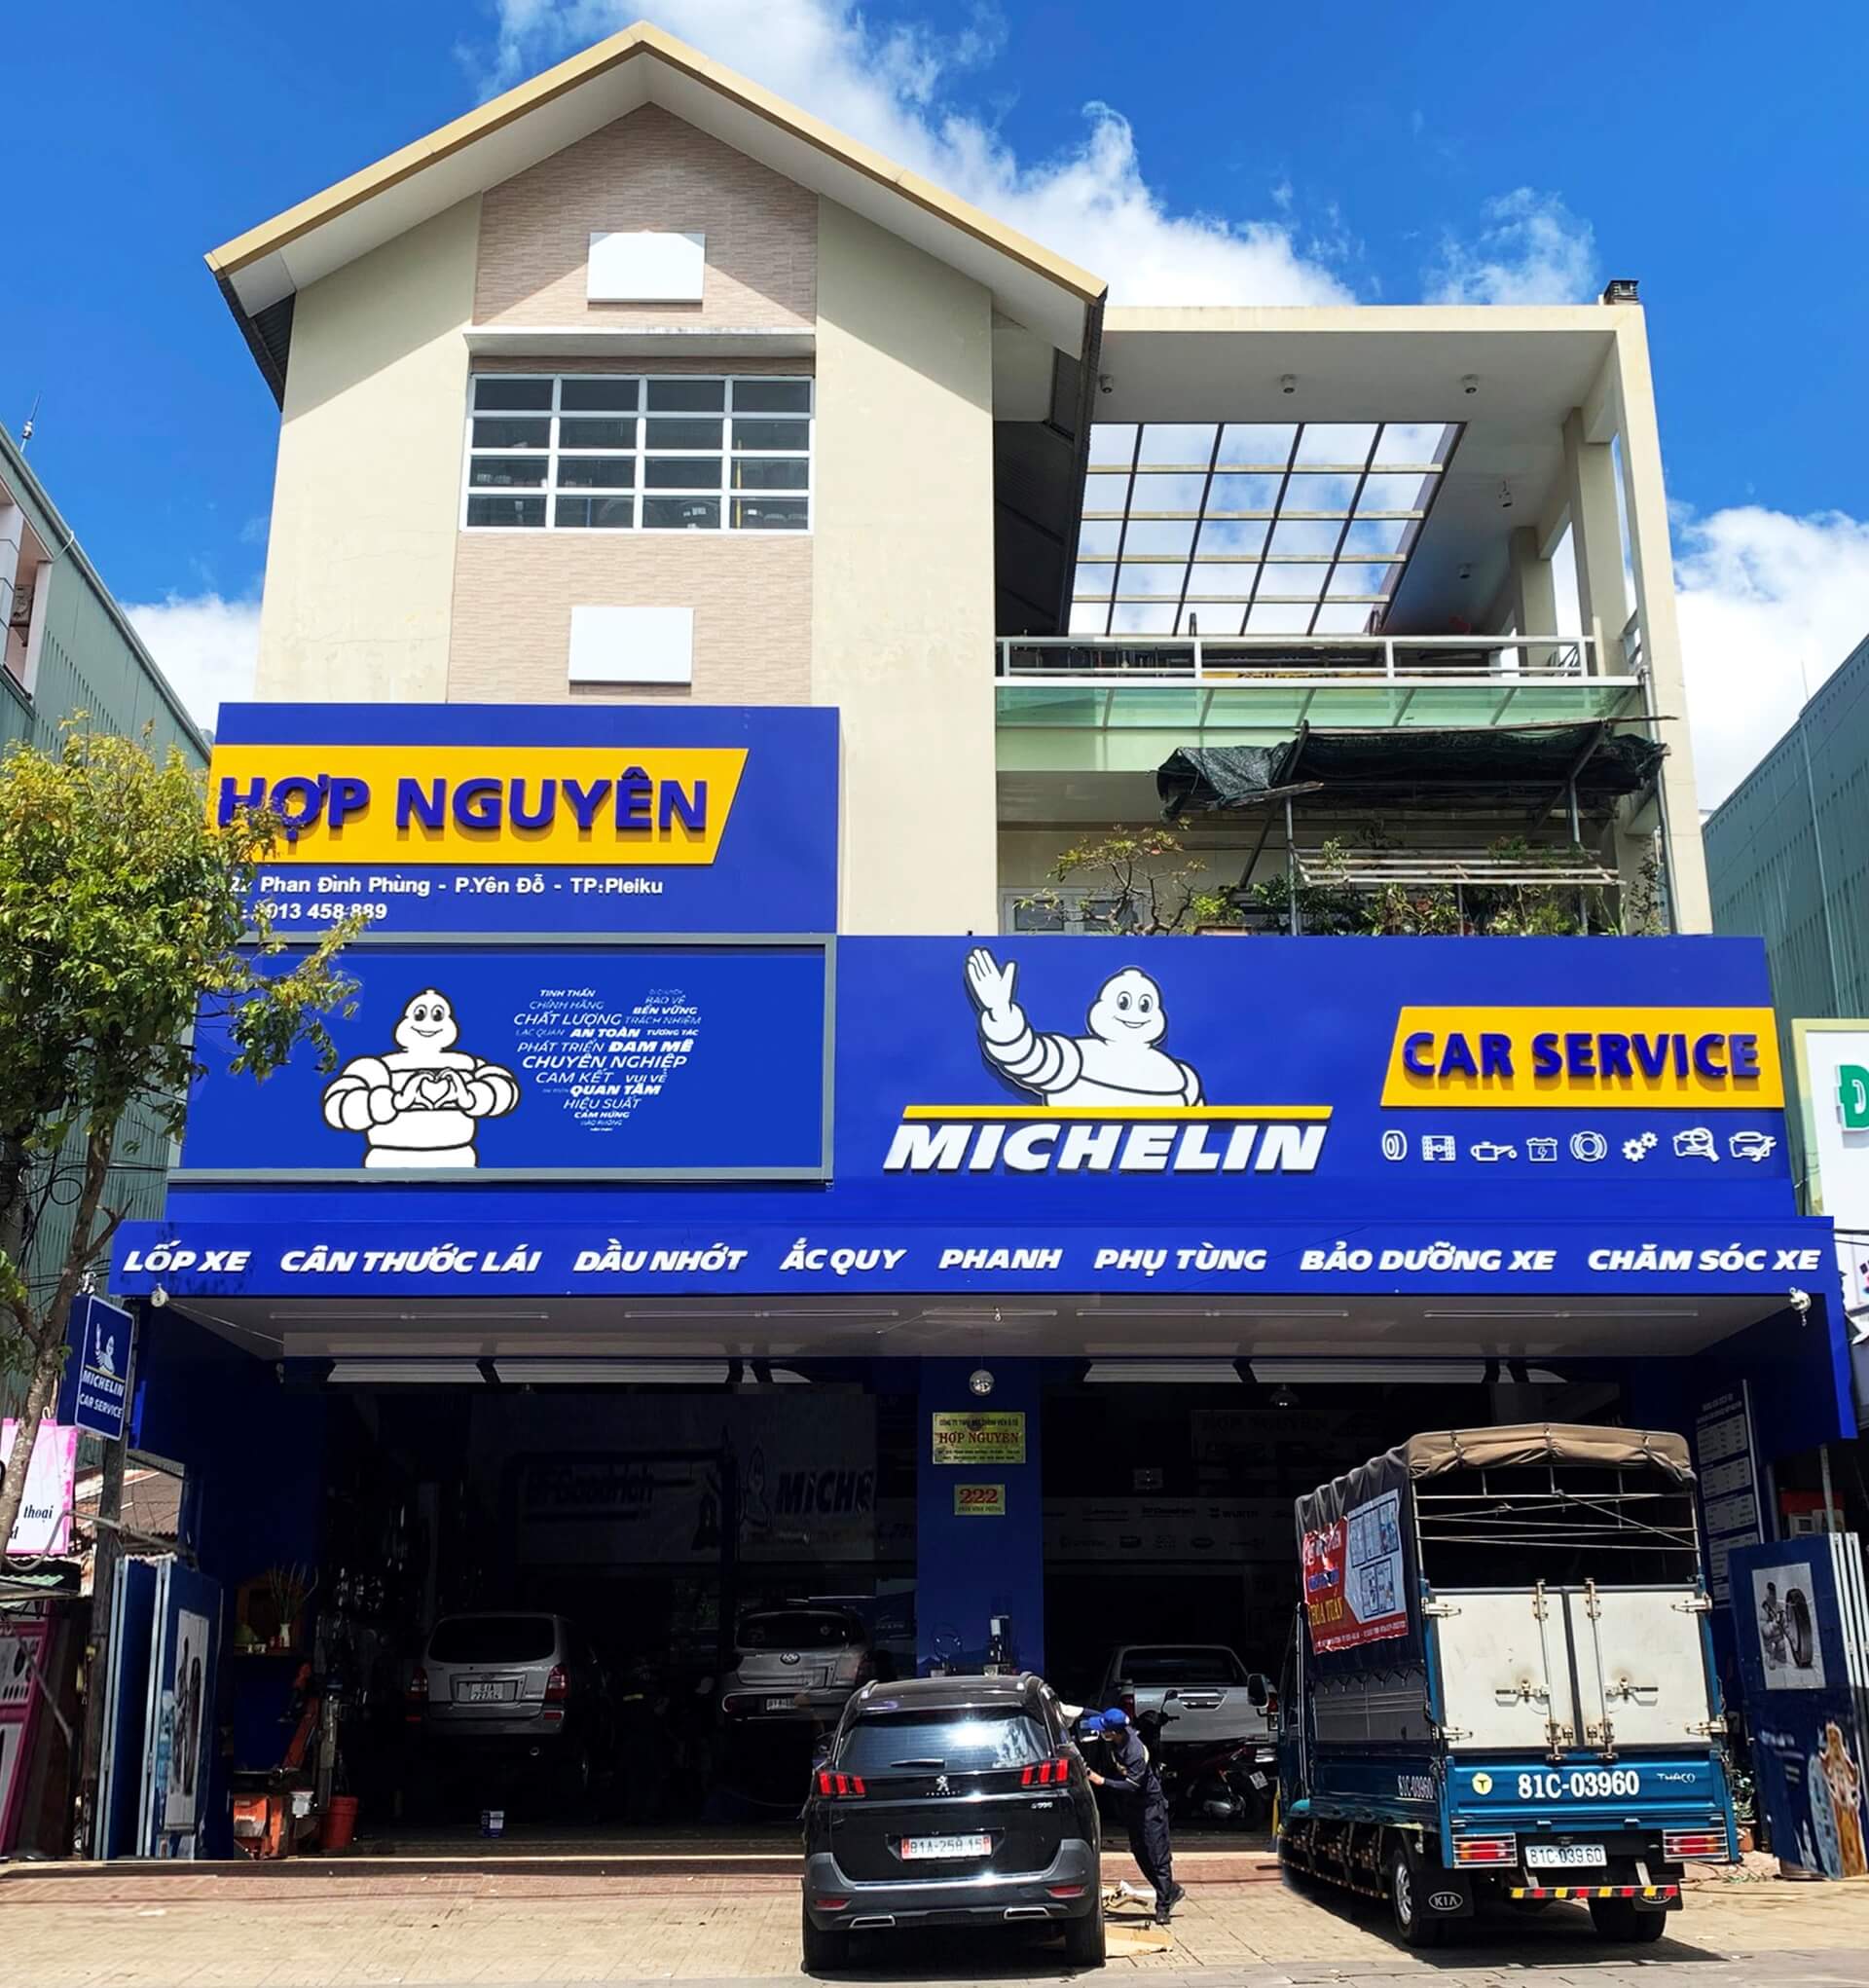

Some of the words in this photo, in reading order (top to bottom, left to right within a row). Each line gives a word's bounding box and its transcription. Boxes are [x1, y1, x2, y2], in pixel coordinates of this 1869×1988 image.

[218, 774, 370, 841] HỢP
[395, 766, 709, 830] NGUYÊN
[260, 876, 312, 893] Phan
[317, 874, 361, 893] Đình
[368, 874, 430, 897] Phùng
[455, 876, 509, 893] P.Yên
[516, 873, 545, 893] Đỗ
[569, 877, 663, 894] TP:Pleiku
[307, 902, 345, 919] 458
[348, 902, 387, 919] 889
[539, 989, 565, 998] TINH
[513, 1010, 561, 1025] CHẤT
[562, 1012, 623, 1028] LƯỢNG
[569, 1028, 595, 1038] AN
[597, 1026, 641, 1038] TOÀN
[517, 1039, 559, 1052] PHÁT
[660, 1038, 694, 1052] MÊ
[1403, 1032, 1516, 1077] CAR
[1532, 1032, 1761, 1078] SERVICE
[522, 1052, 605, 1069] CHUYÊN
[609, 1052, 687, 1070] NGHIỆP
[535, 1072, 575, 1084] CAM
[578, 1068, 614, 1084] KẾT
[625, 1074, 648, 1084] VUI
[569, 1085, 619, 1097] QUAN
[623, 1082, 662, 1095] TÂM
[601, 1094, 641, 1110] SUẤT
[883, 1124, 1328, 1170] MICHELIN
[122, 1240, 198, 1273] LỐP
[198, 1250, 251, 1273] XE
[280, 1244, 359, 1273] CÂN
[363, 1241, 477, 1273] THƯỚC
[480, 1243, 542, 1273] LÁI
[649, 1240, 748, 1271] NHỚT
[779, 1236, 828, 1271] ẮC
[829, 1248, 907, 1275] QUY
[937, 1248, 1064, 1270] PHANH
[1093, 1249, 1168, 1277] PHỤ
[1176, 1241, 1267, 1271] TÙNG
[1300, 1240, 1374, 1271] BẢO
[1378, 1240, 1502, 1271] DƯỠNG
[1508, 1249, 1558, 1271] XE
[1588, 1242, 1693, 1271] CHĂM
[1698, 1242, 1767, 1271] SÓC
[1772, 1249, 1822, 1271] XE
[82, 1370, 125, 1398] MICHELIN
[79, 1392, 94, 1409] CAR
[92, 1398, 124, 1418] SERVICE
[959, 1488, 999, 1504] 222
[23, 1504, 55, 1523] thoại
[1518, 1770, 1640, 1799] 81C-03960
[1434, 1896, 1459, 1907] KIA
